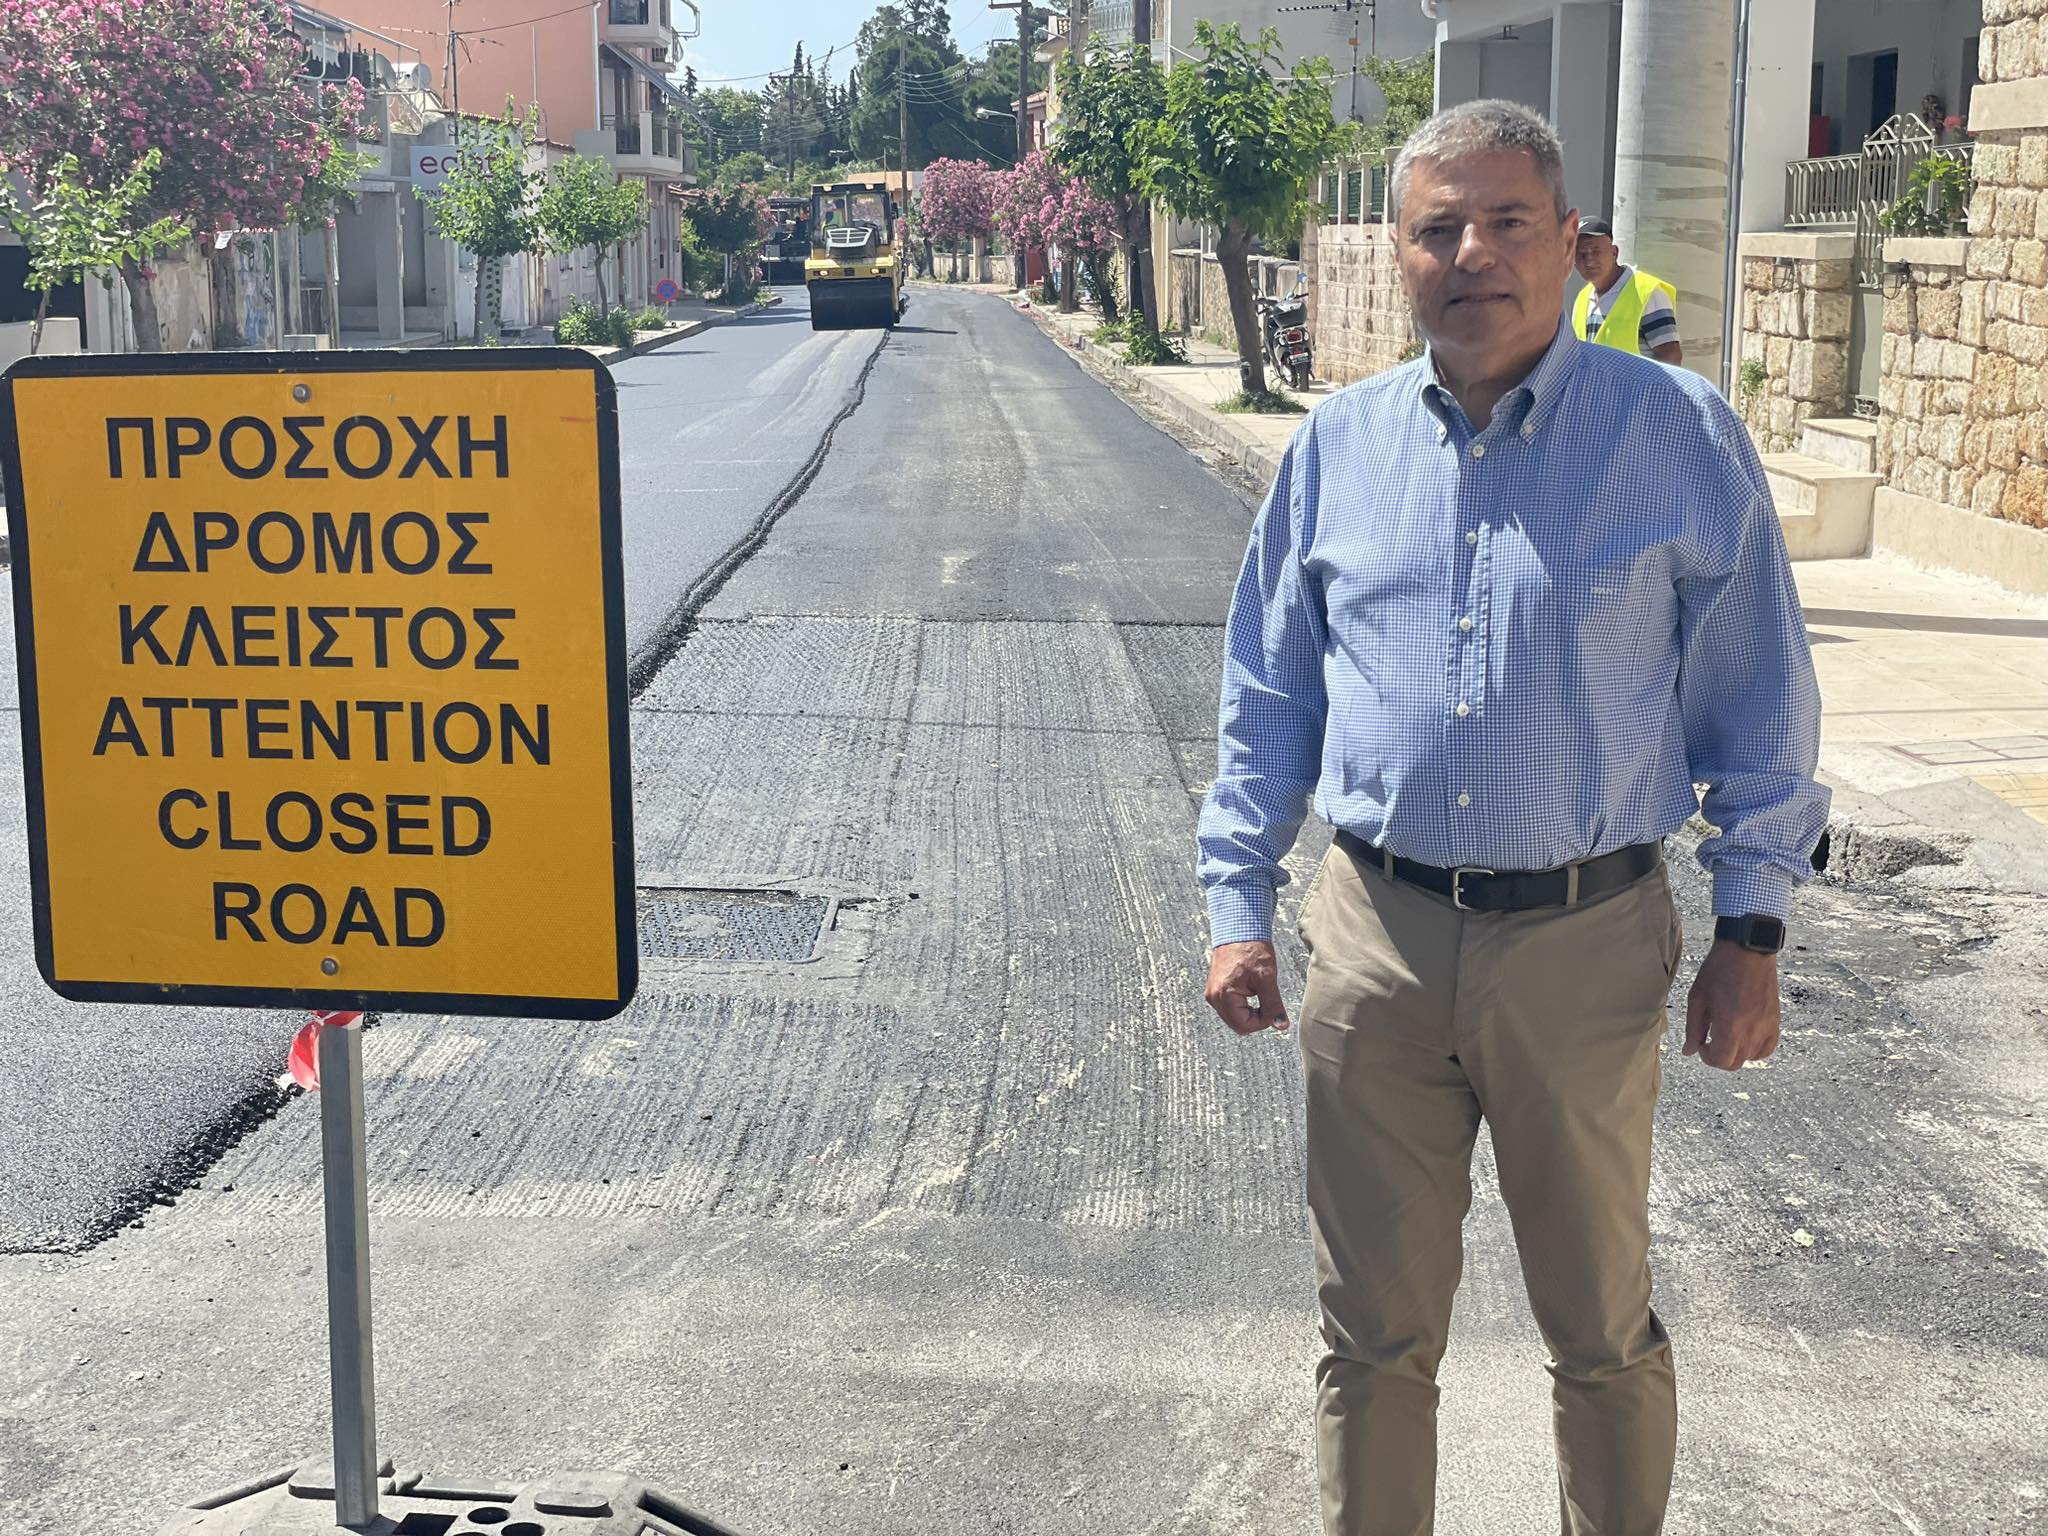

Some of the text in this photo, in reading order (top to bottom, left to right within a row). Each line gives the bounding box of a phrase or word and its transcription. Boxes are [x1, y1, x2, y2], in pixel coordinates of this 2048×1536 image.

[105, 415, 509, 480] ΠΡΟΣΟΧΗ
[132, 511, 493, 575] ΔΡΟΜΟΣ
[118, 604, 520, 670] ΚΛΕΙΣΤΟΣ
[92, 696, 551, 766] ATTENTION
[158, 788, 492, 857] CLOSED
[212, 881, 446, 948] ROAD
